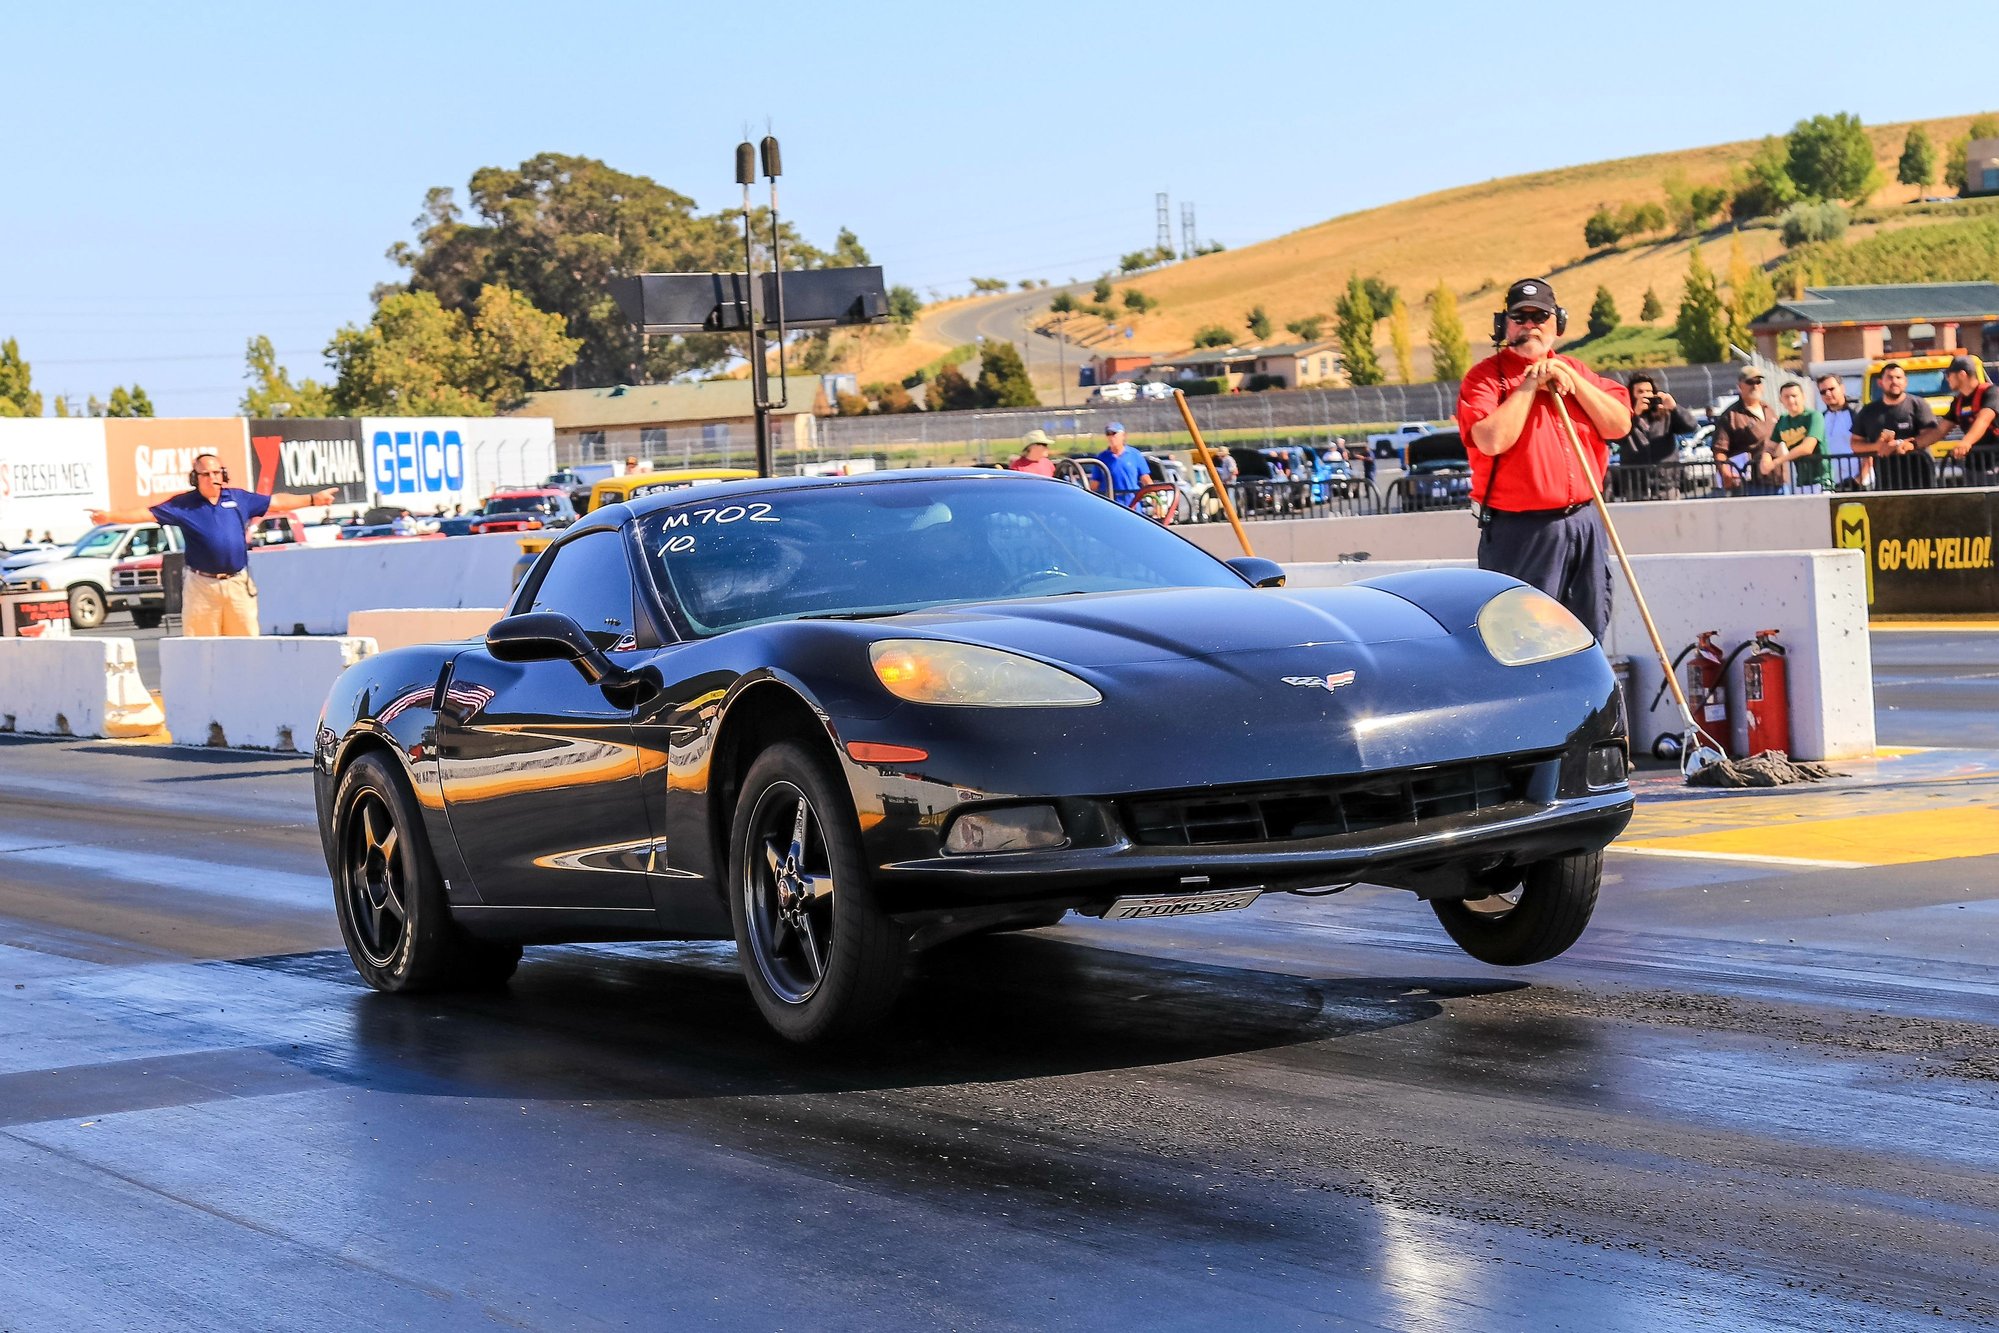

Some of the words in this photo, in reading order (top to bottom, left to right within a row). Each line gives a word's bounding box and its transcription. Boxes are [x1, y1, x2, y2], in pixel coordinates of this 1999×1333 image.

[14, 464, 57, 491] FRESH
[61, 463, 92, 489] MEX
[373, 430, 464, 495] GEICO
